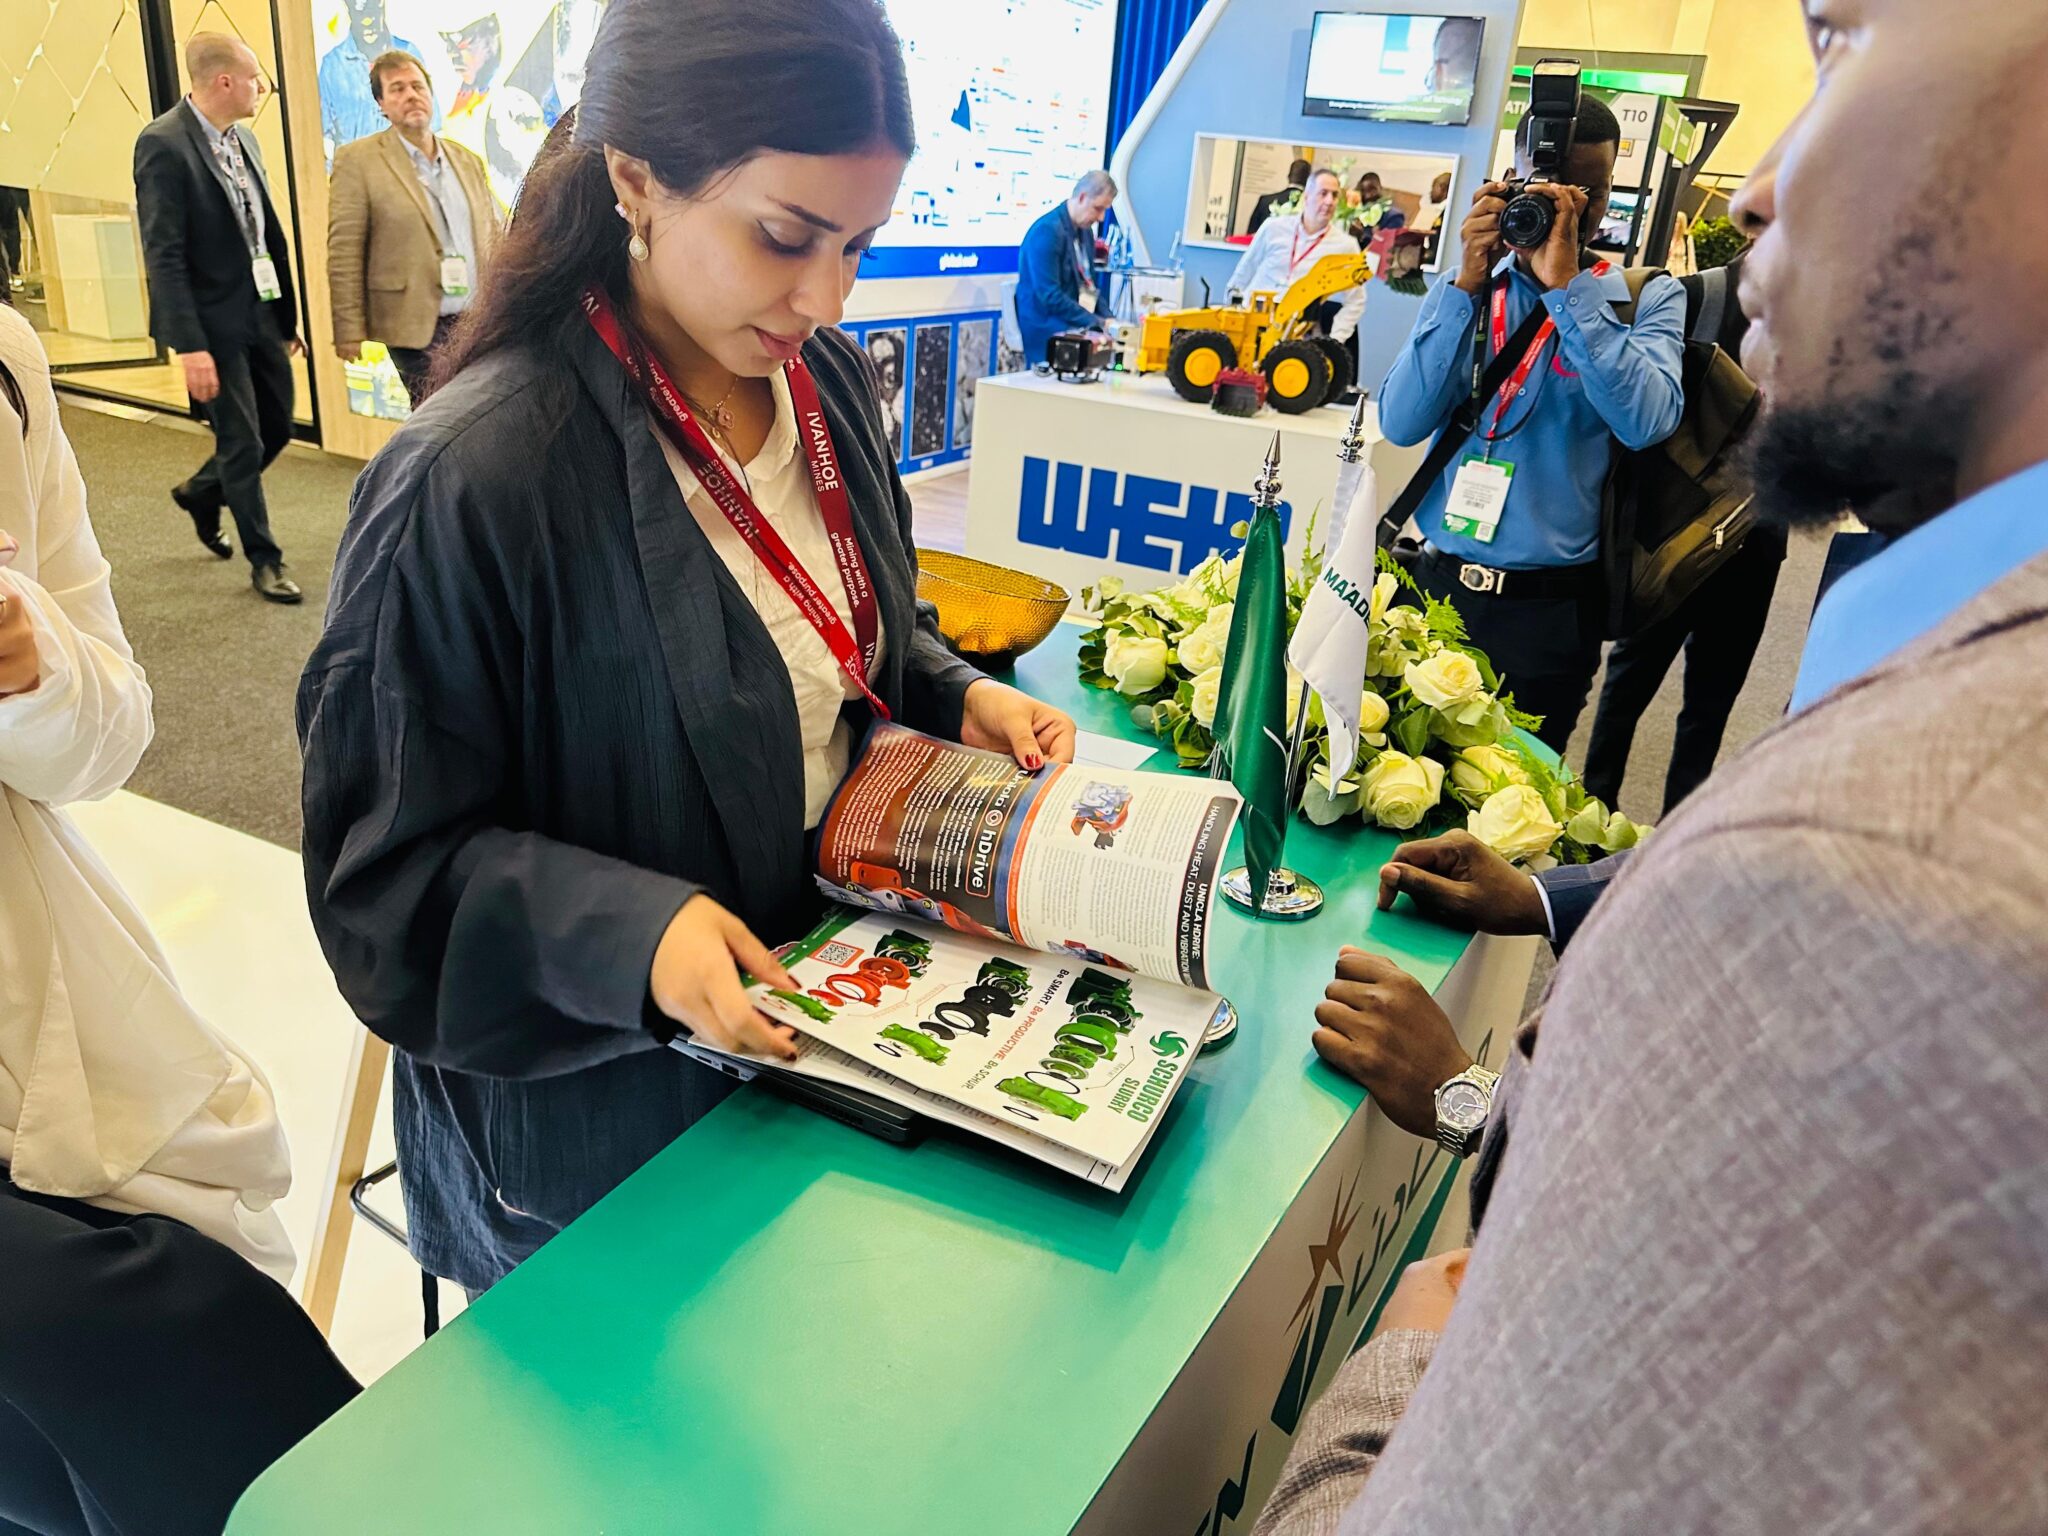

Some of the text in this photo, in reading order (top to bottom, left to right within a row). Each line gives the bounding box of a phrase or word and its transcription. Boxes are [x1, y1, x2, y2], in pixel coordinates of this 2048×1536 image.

[1621, 108, 1648, 123] T10
[660, 386, 689, 422] greater
[806, 411, 839, 491] IVANHOE
[710, 458, 737, 489] MINES
[811, 459, 825, 493] MINES
[830, 532, 860, 608] greater purpose.
[844, 537, 858, 569] Mining
[855, 569, 867, 589] with
[783, 575, 824, 628] Mining with a
[788, 561, 837, 625] greater purpose.
[1197, 805, 1220, 849] HANDLING
[970, 829, 995, 888] hDrive
[1186, 852, 1202, 878] HEAT,
[1183, 881, 1195, 909] DUST
[1180, 911, 1191, 931] AND
[1192, 883, 1207, 959] UNICLA HDRIVE:
[1180, 933, 1190, 972] VIBRATION
[961, 969, 1070, 1090] Be SMART. Be PRODUCTIVE. Be SCHUR.
[1107, 1077, 1139, 1113] SLURRY
[1126, 1059, 1177, 1122] SCHURCO
